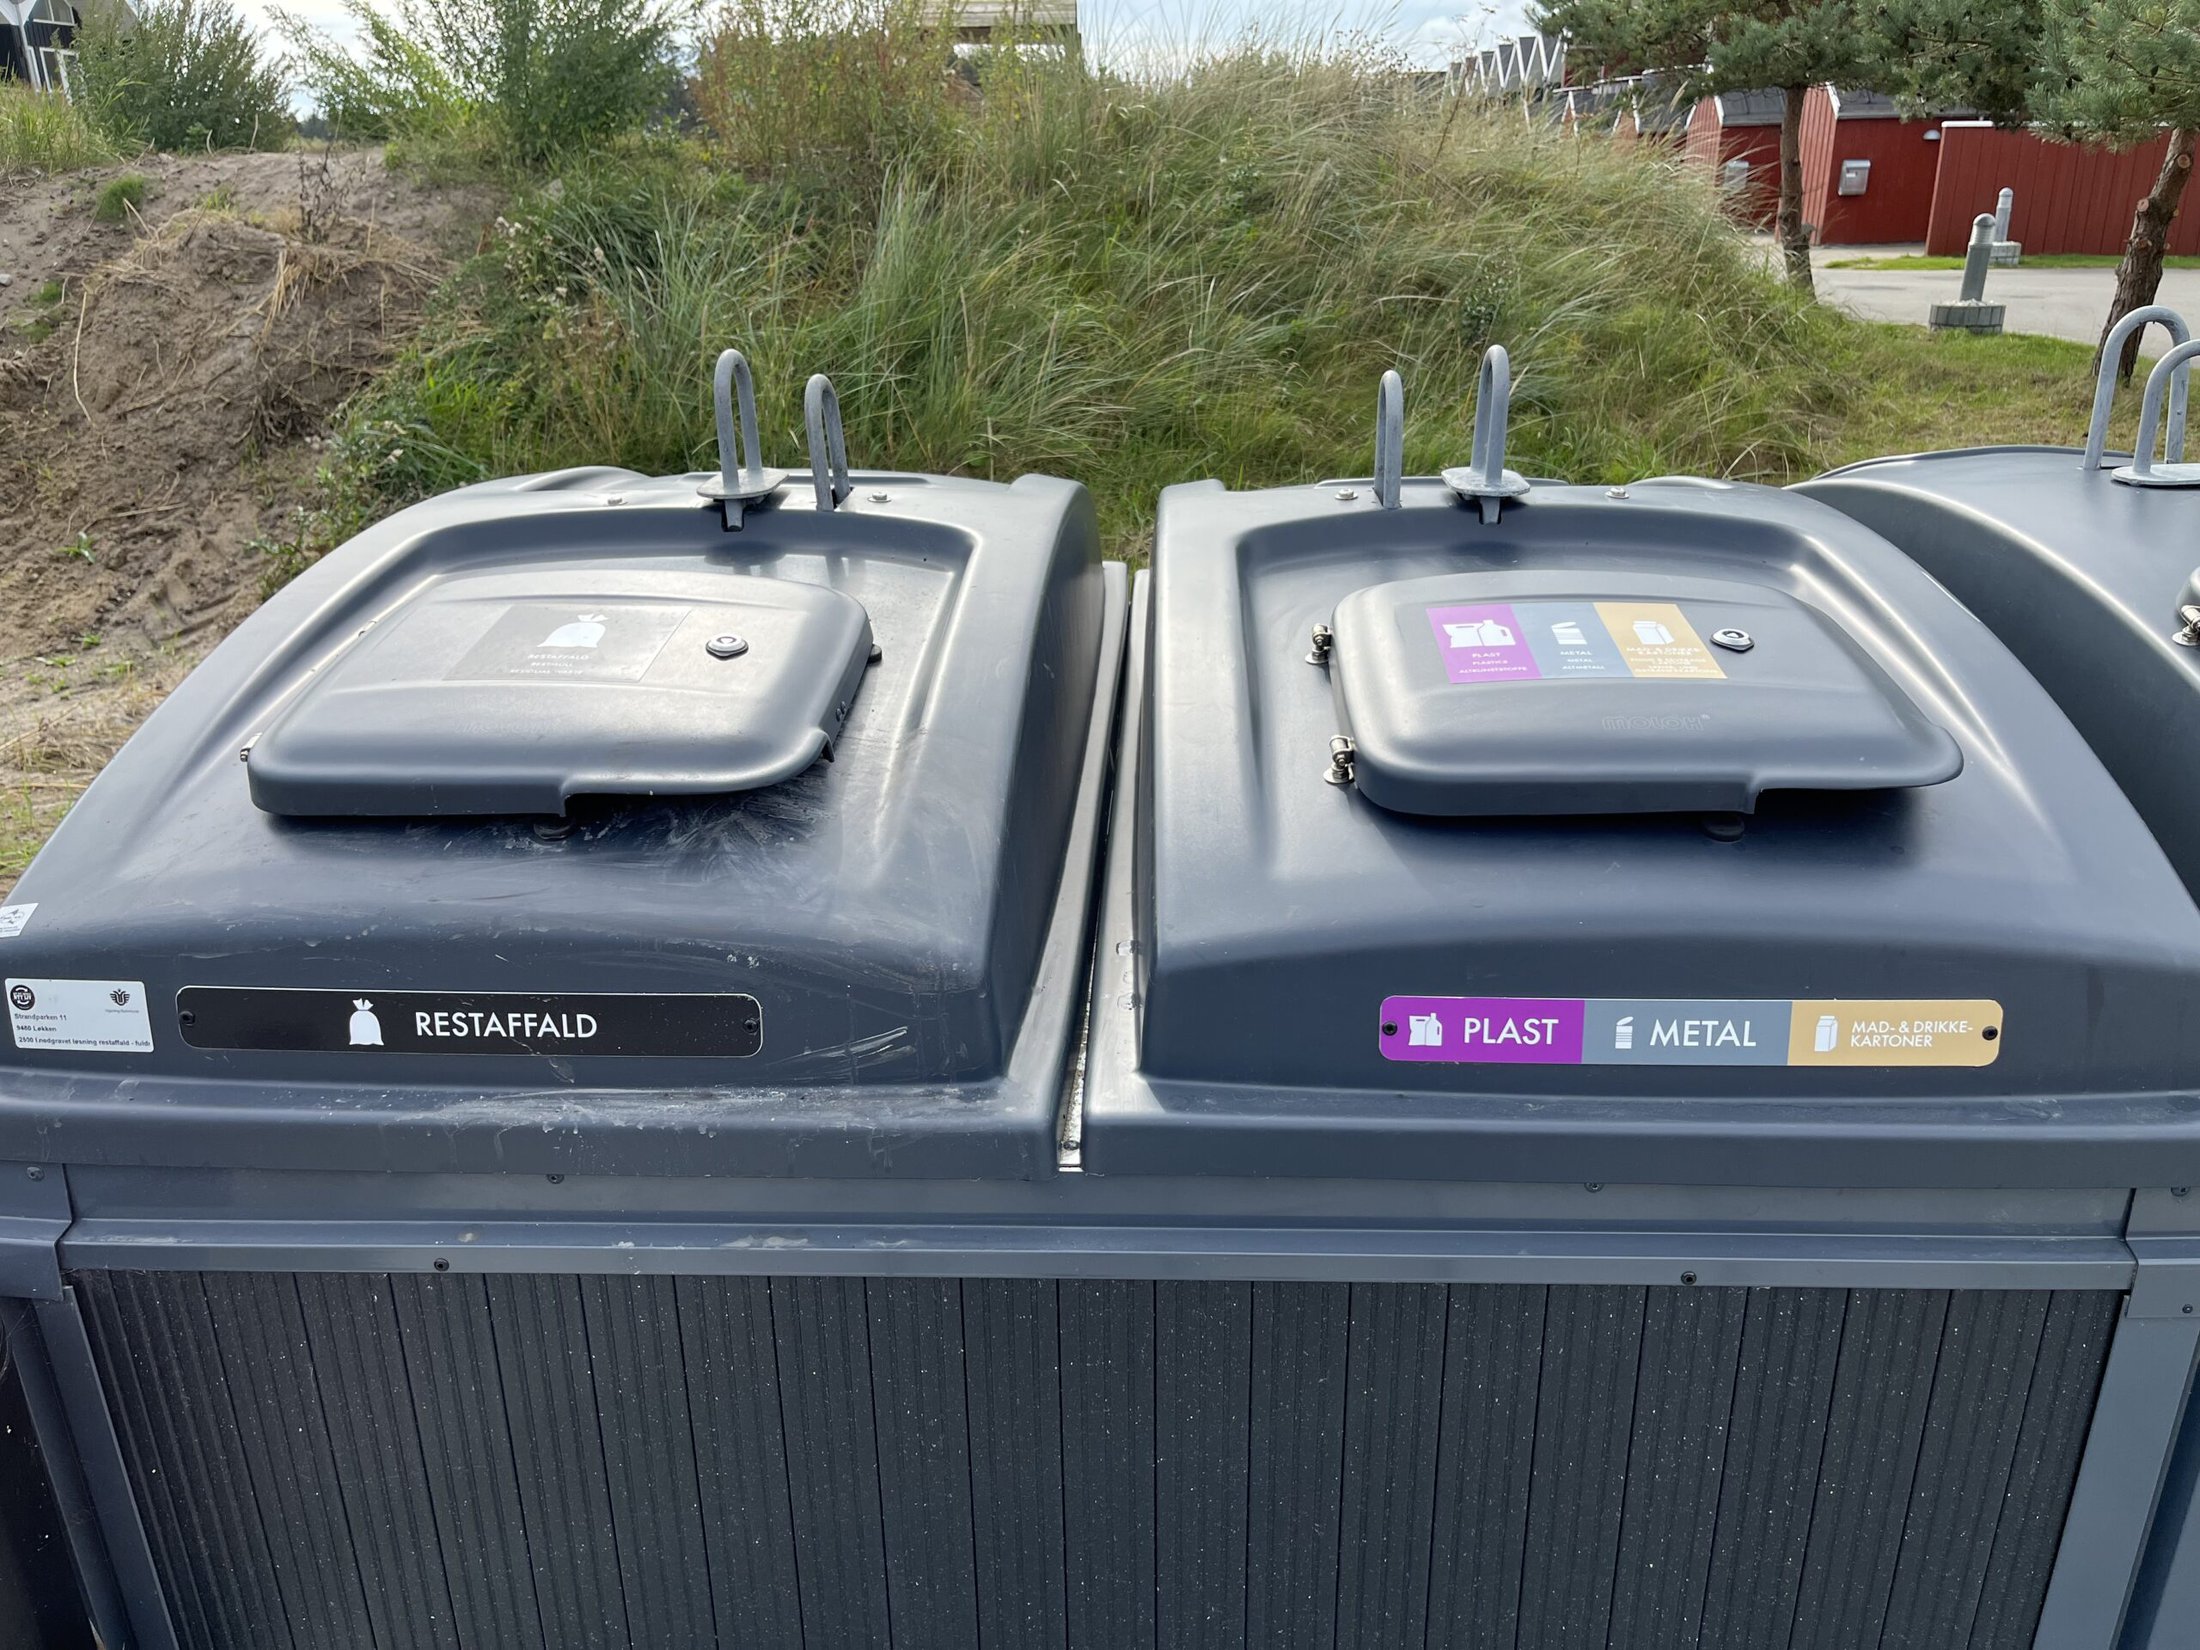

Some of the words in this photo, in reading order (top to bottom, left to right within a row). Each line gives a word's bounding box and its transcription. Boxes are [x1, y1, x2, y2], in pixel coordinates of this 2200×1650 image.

[14, 1013, 58, 1021] Strandparken
[415, 1012, 597, 1038] RESTAFFALD
[1851, 1020, 1895, 1033] MAD-
[1898, 1020, 1910, 1033] &
[1913, 1021, 1974, 1034] DRIKKE-
[1463, 1017, 1560, 1046] PLAST
[1649, 1020, 1757, 1048] METAL
[1850, 1034, 1933, 1048] KARTONER
